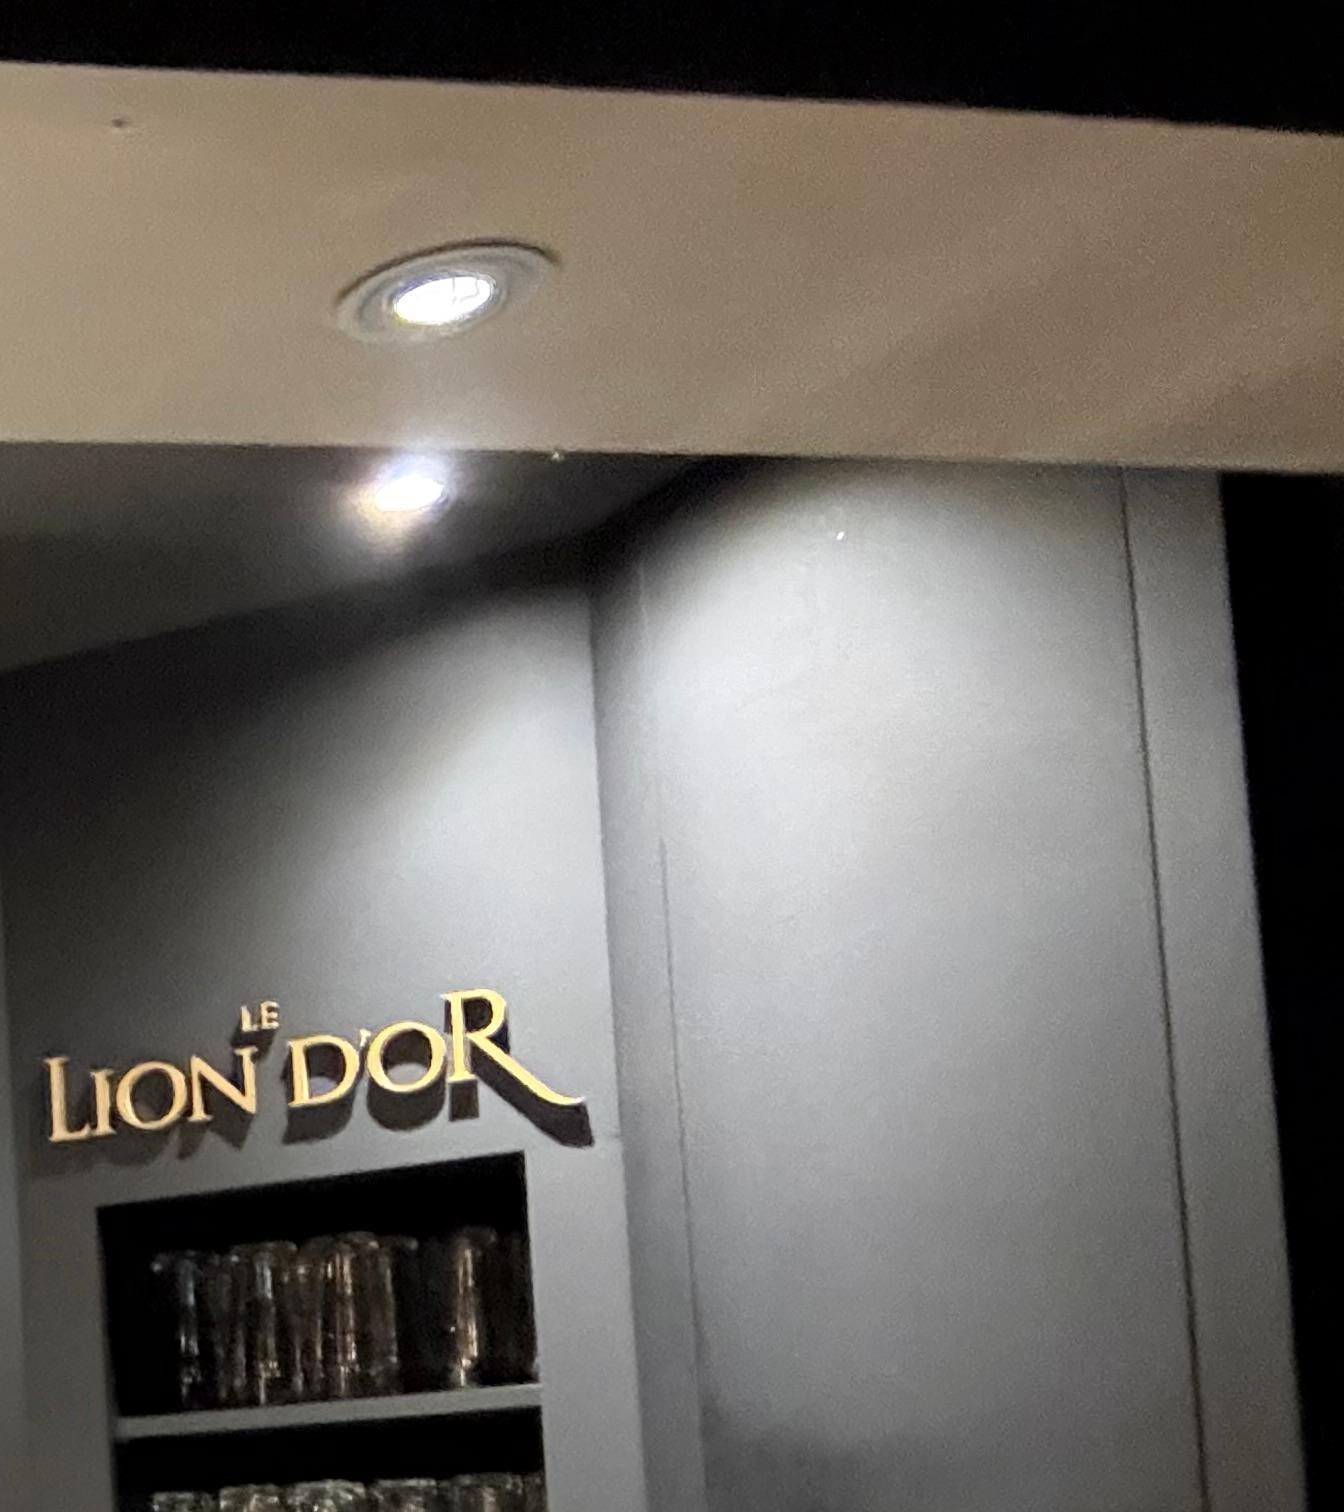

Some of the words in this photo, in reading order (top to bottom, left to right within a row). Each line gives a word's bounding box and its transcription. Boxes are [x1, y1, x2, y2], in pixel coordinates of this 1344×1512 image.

[240, 1001, 280, 1033] LE
[43, 1046, 259, 1143] LION
[287, 988, 586, 1108] D'OR
